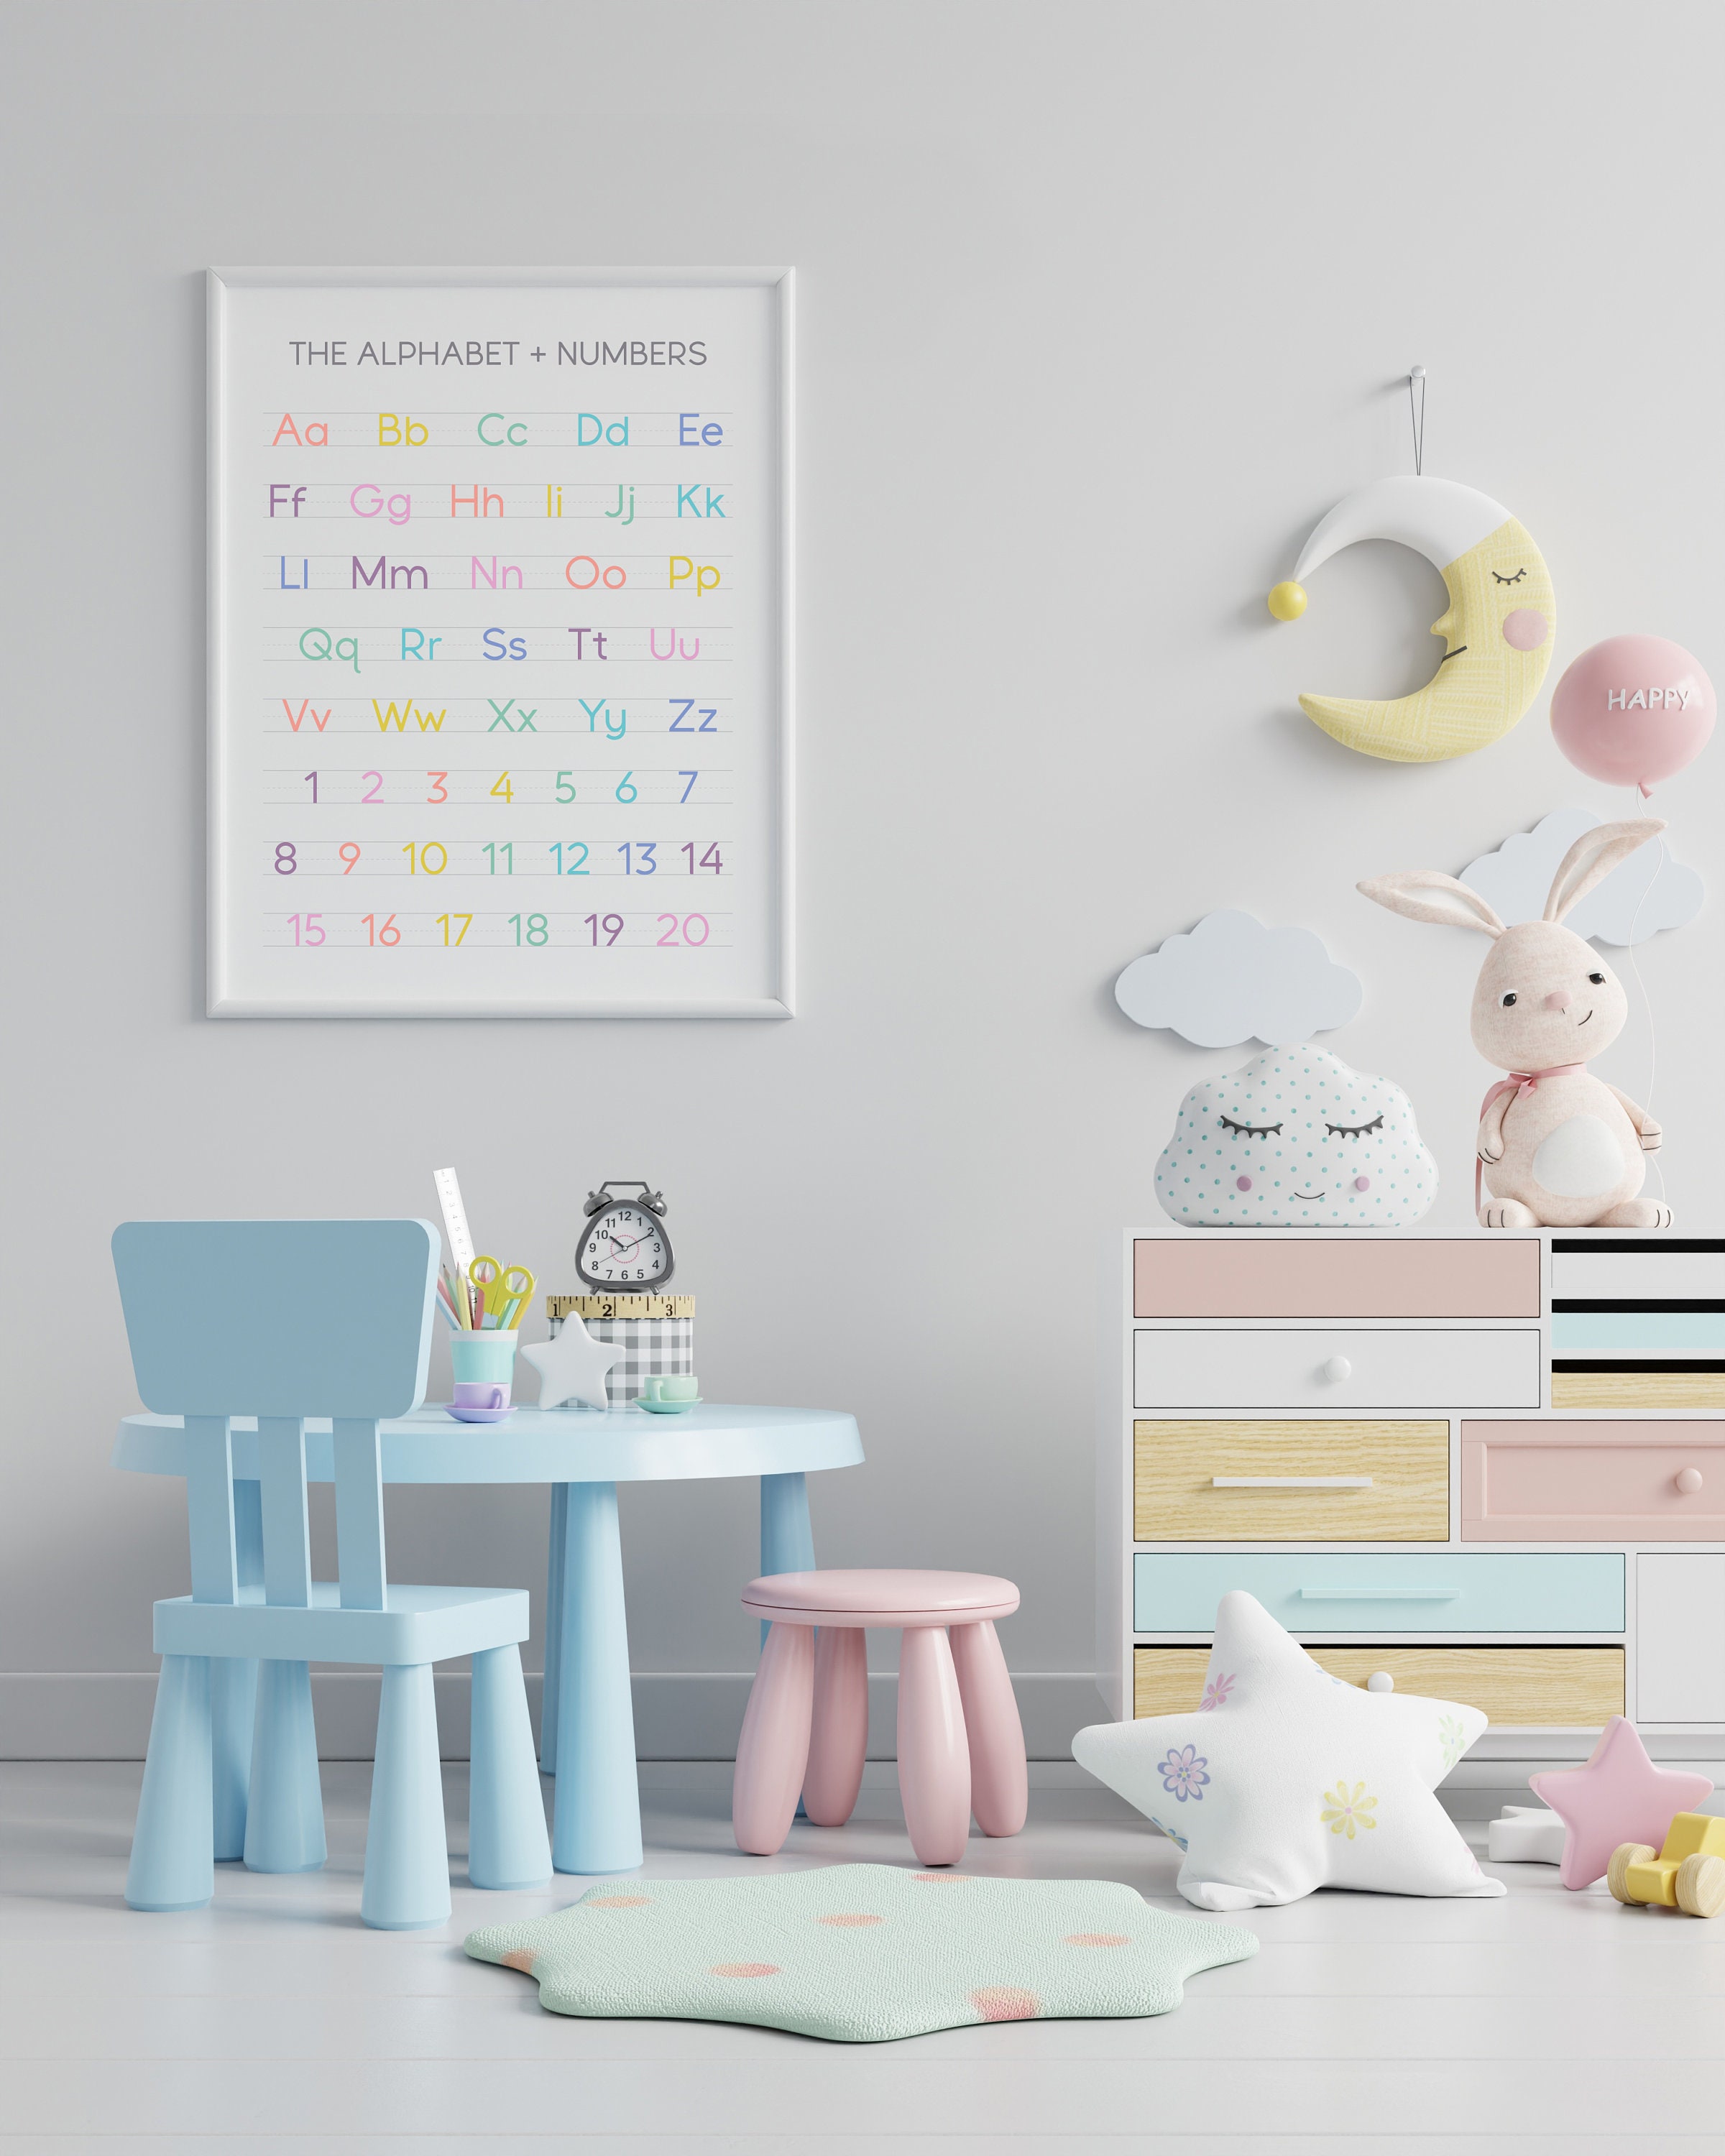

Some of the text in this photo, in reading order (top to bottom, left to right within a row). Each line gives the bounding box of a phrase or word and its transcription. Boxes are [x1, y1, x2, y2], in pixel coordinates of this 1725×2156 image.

[288, 341, 707, 366] THE ALPHABET + NUMBERS
[271, 412, 724, 447] Aa Bb Cc Dd Ee
[270, 483, 727, 526] Ff Gg Hh Ii Jj Kk
[280, 554, 722, 598] Ll Mm Nn Oo Pp
[298, 627, 700, 675] Qq Rr Ss Tt Uu
[1608, 687, 1690, 711] HAPPY
[282, 698, 718, 741] Vv Ww Xx Yy Zz
[305, 770, 699, 805] 1 2 3 4 5 6 7
[274, 841, 723, 876] 8 9 10 11 12 13 14
[287, 913, 709, 947] 15 16 17 18 19 20
[618, 1211, 632, 1221] 12
[605, 1218, 616, 1227] 11
[637, 1217, 642, 1227] 1
[595, 1230, 608, 1240] 10
[648, 1227, 654, 1237] 2
[589, 1243, 597, 1253] 9
[653, 1243, 661, 1253] 3
[592, 1261, 599, 1271] 8
[652, 1260, 660, 1269] 4
[606, 1269, 613, 1279] 7
[621, 1270, 628, 1280] 6
[637, 1269, 644, 1279] 5
[553, 1304, 673, 1317] 1 2 3
